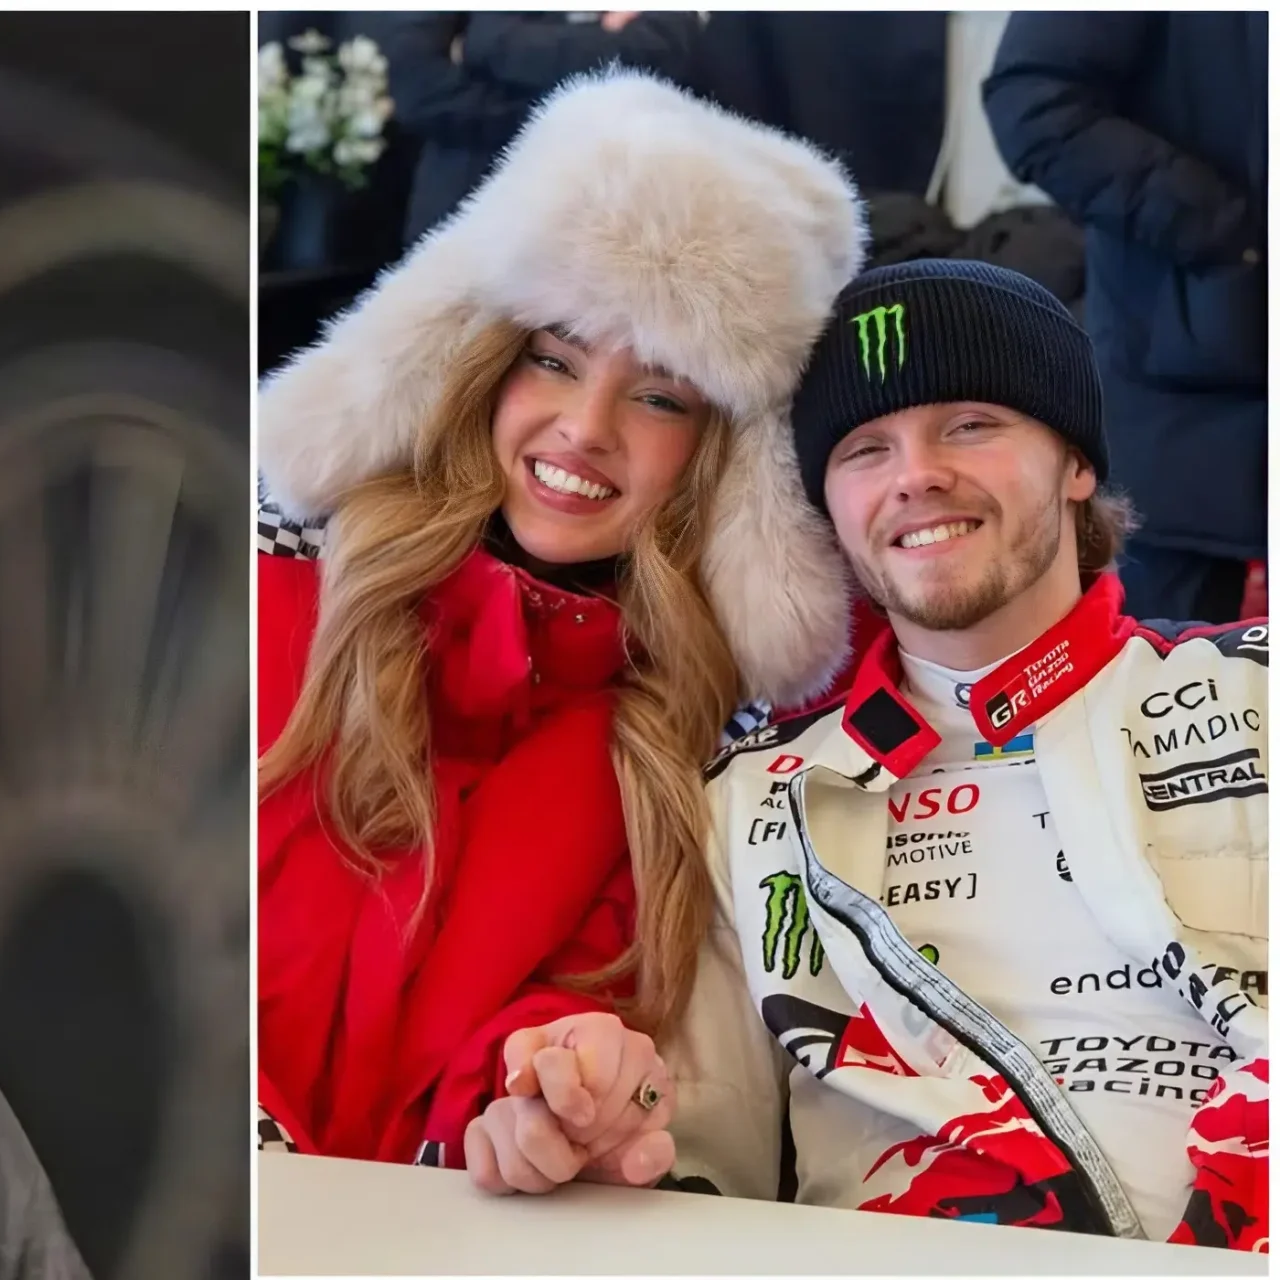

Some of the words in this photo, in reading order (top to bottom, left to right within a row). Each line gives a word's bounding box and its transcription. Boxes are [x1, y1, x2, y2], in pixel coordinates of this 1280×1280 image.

[991, 688, 1027, 728] GR
[1140, 678, 1219, 719] CCi
[887, 840, 973, 867] MOTIVE
[1040, 1035, 1240, 1063] TOYOTA
[1056, 1077, 1211, 1108] acing
